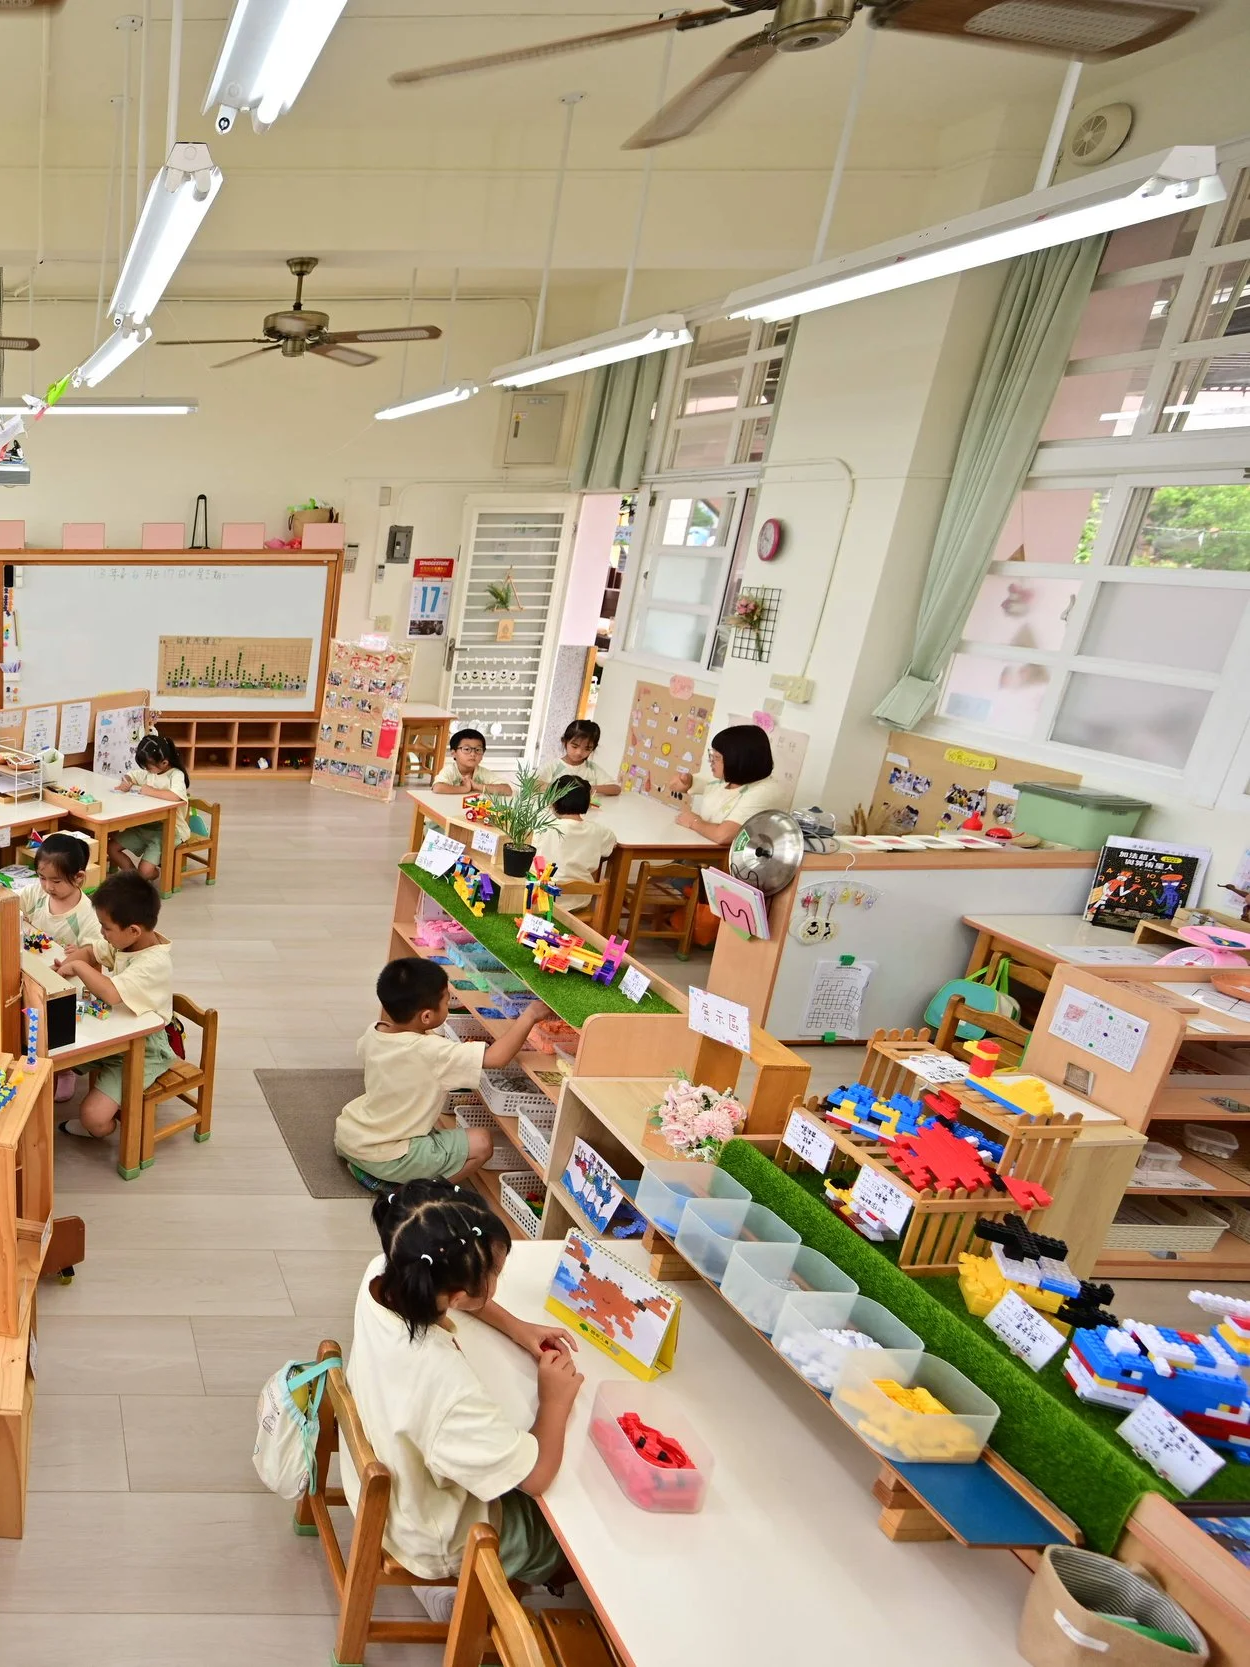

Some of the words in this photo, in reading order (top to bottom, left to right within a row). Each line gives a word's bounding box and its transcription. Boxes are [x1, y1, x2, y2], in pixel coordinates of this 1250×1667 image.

[420, 586, 441, 613] 17
[1119, 851, 1158, 862] 加法超人
[701, 1002, 739, 1033] 展示區
